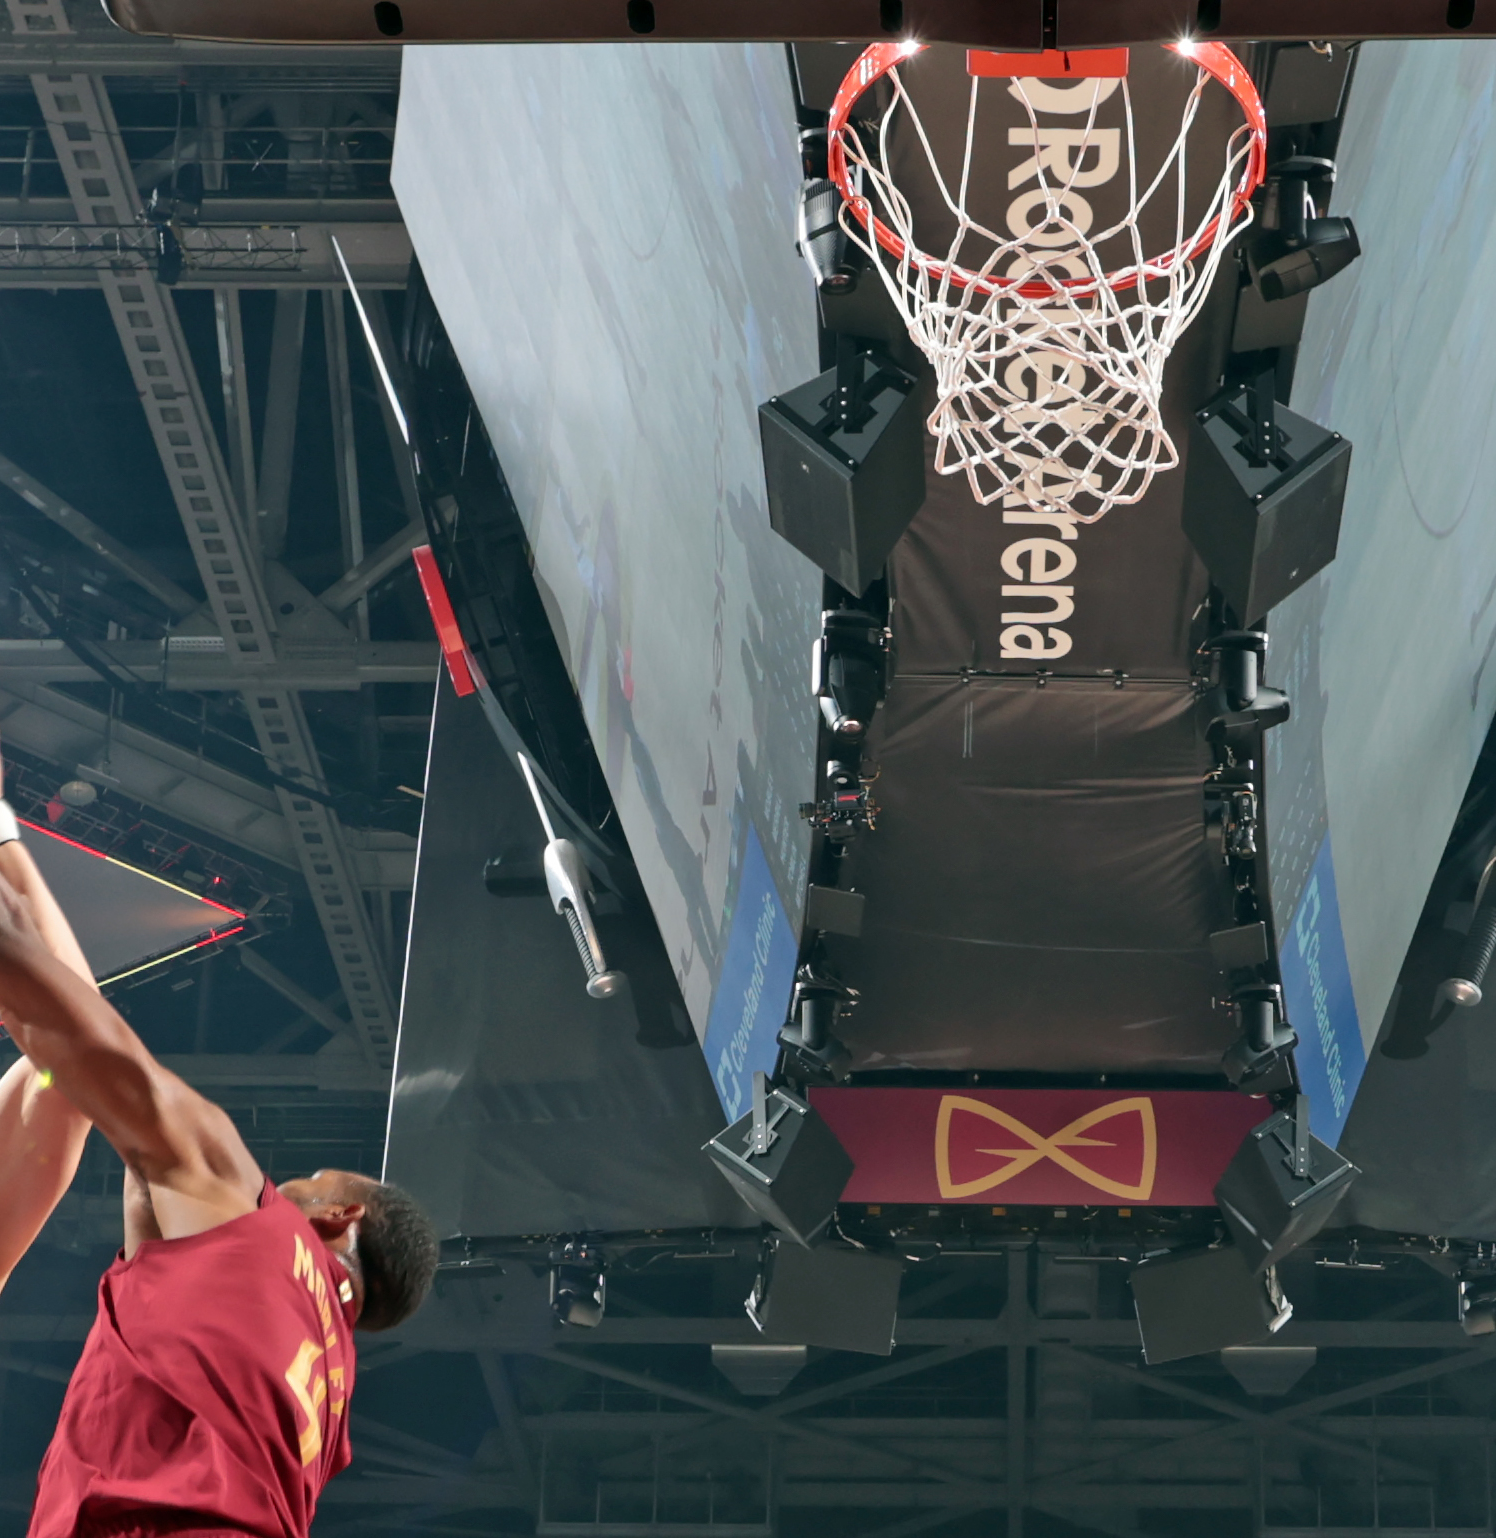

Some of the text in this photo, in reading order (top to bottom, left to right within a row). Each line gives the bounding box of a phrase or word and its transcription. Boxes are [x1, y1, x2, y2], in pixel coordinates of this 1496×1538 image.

[728, 892, 776, 1073] Cleveland Clinic
[1306, 932, 1346, 1118] Cleveland Clinic
